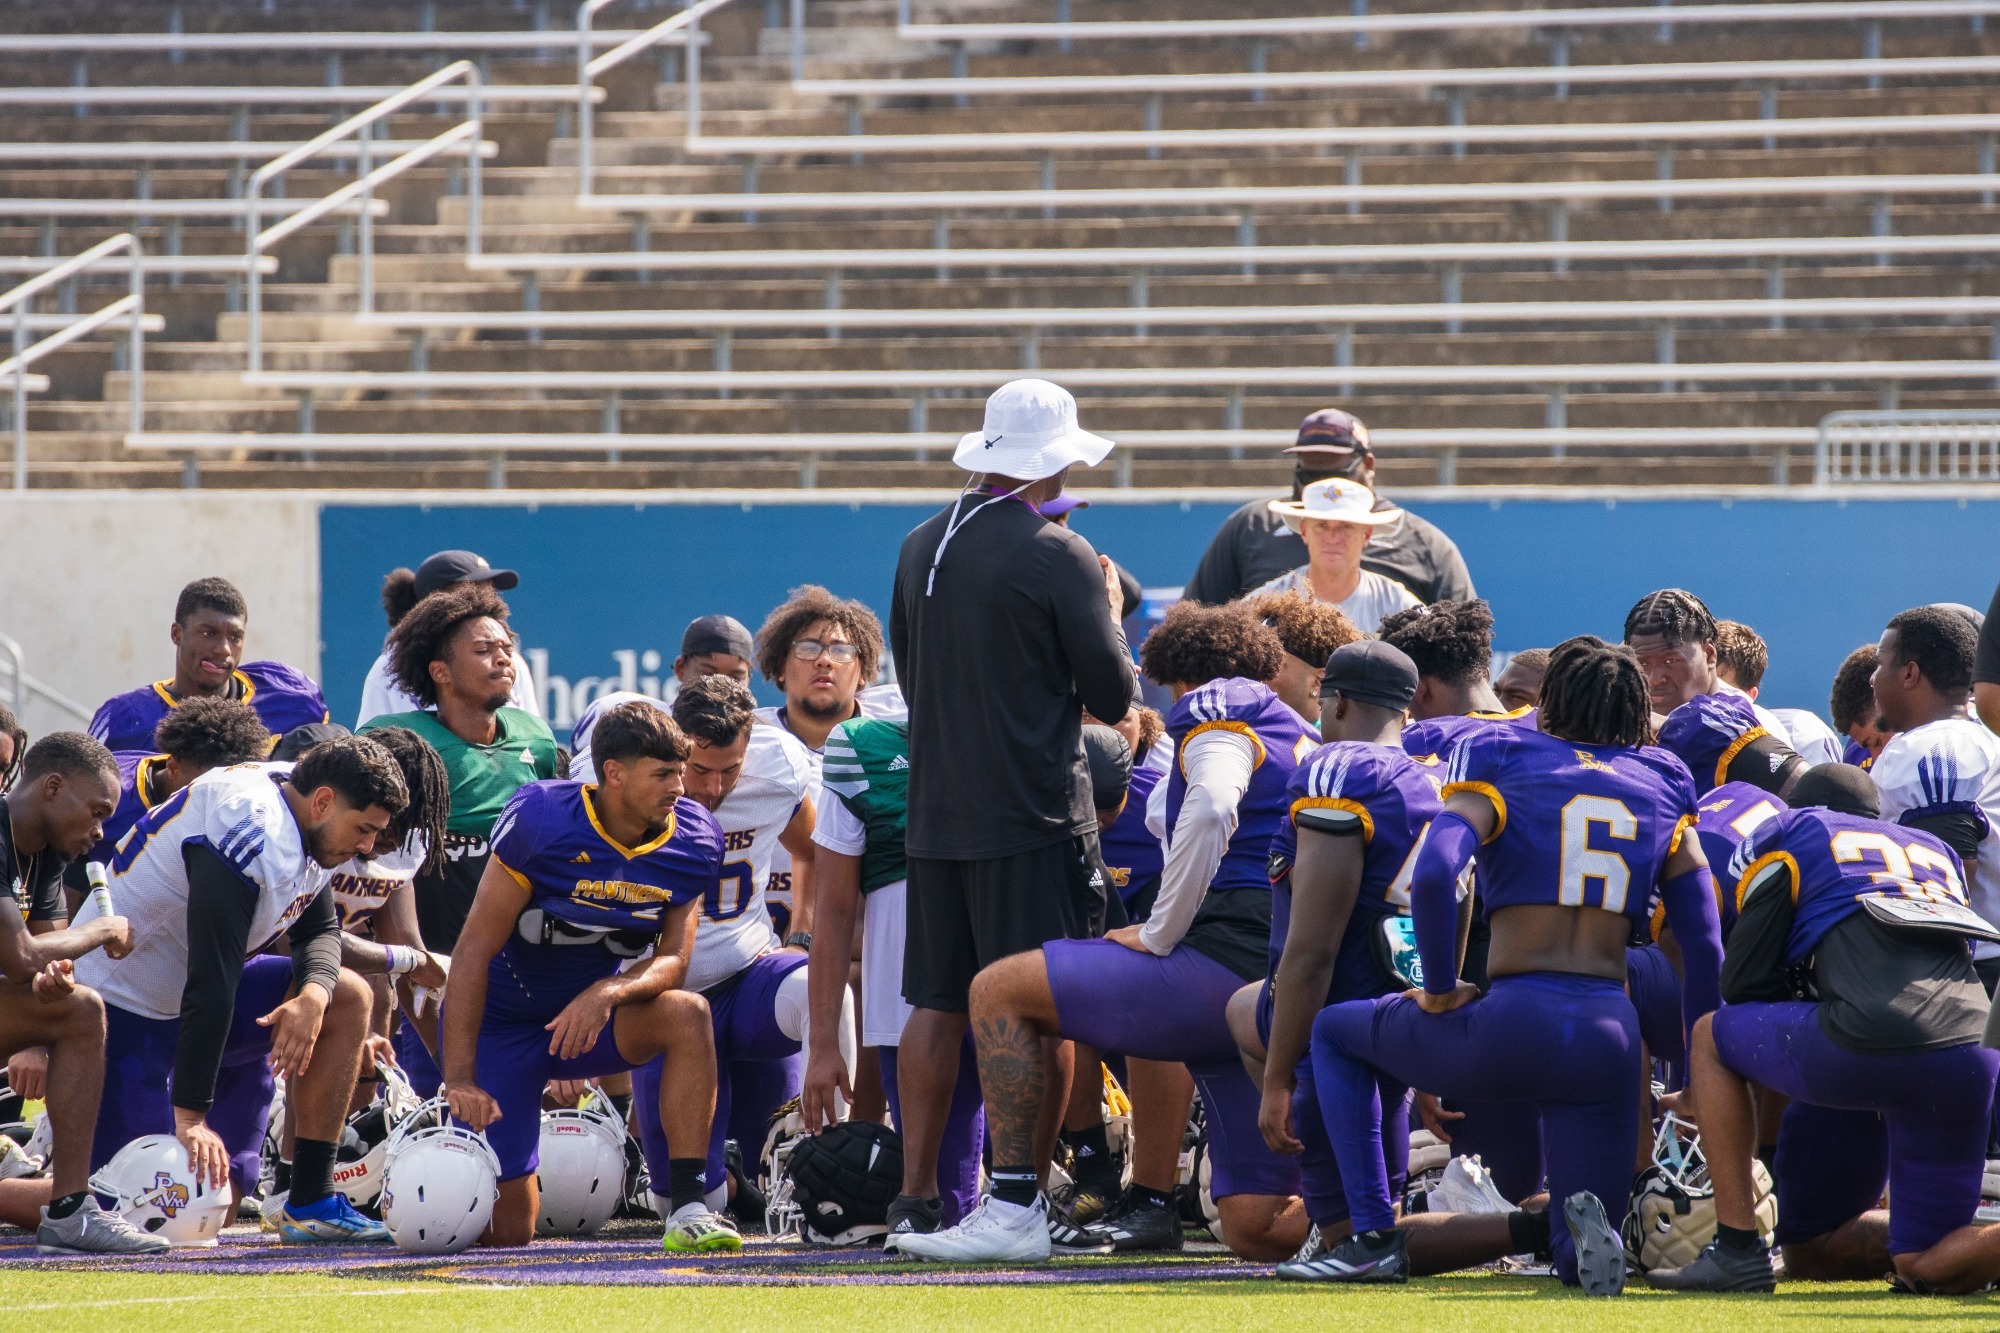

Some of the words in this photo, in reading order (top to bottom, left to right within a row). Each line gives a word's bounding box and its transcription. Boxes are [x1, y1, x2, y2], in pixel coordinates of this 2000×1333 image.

[1558, 794, 1638, 914] 6
[572, 879, 672, 904] PANTHERS
[556, 1125, 581, 1133] Riddell
